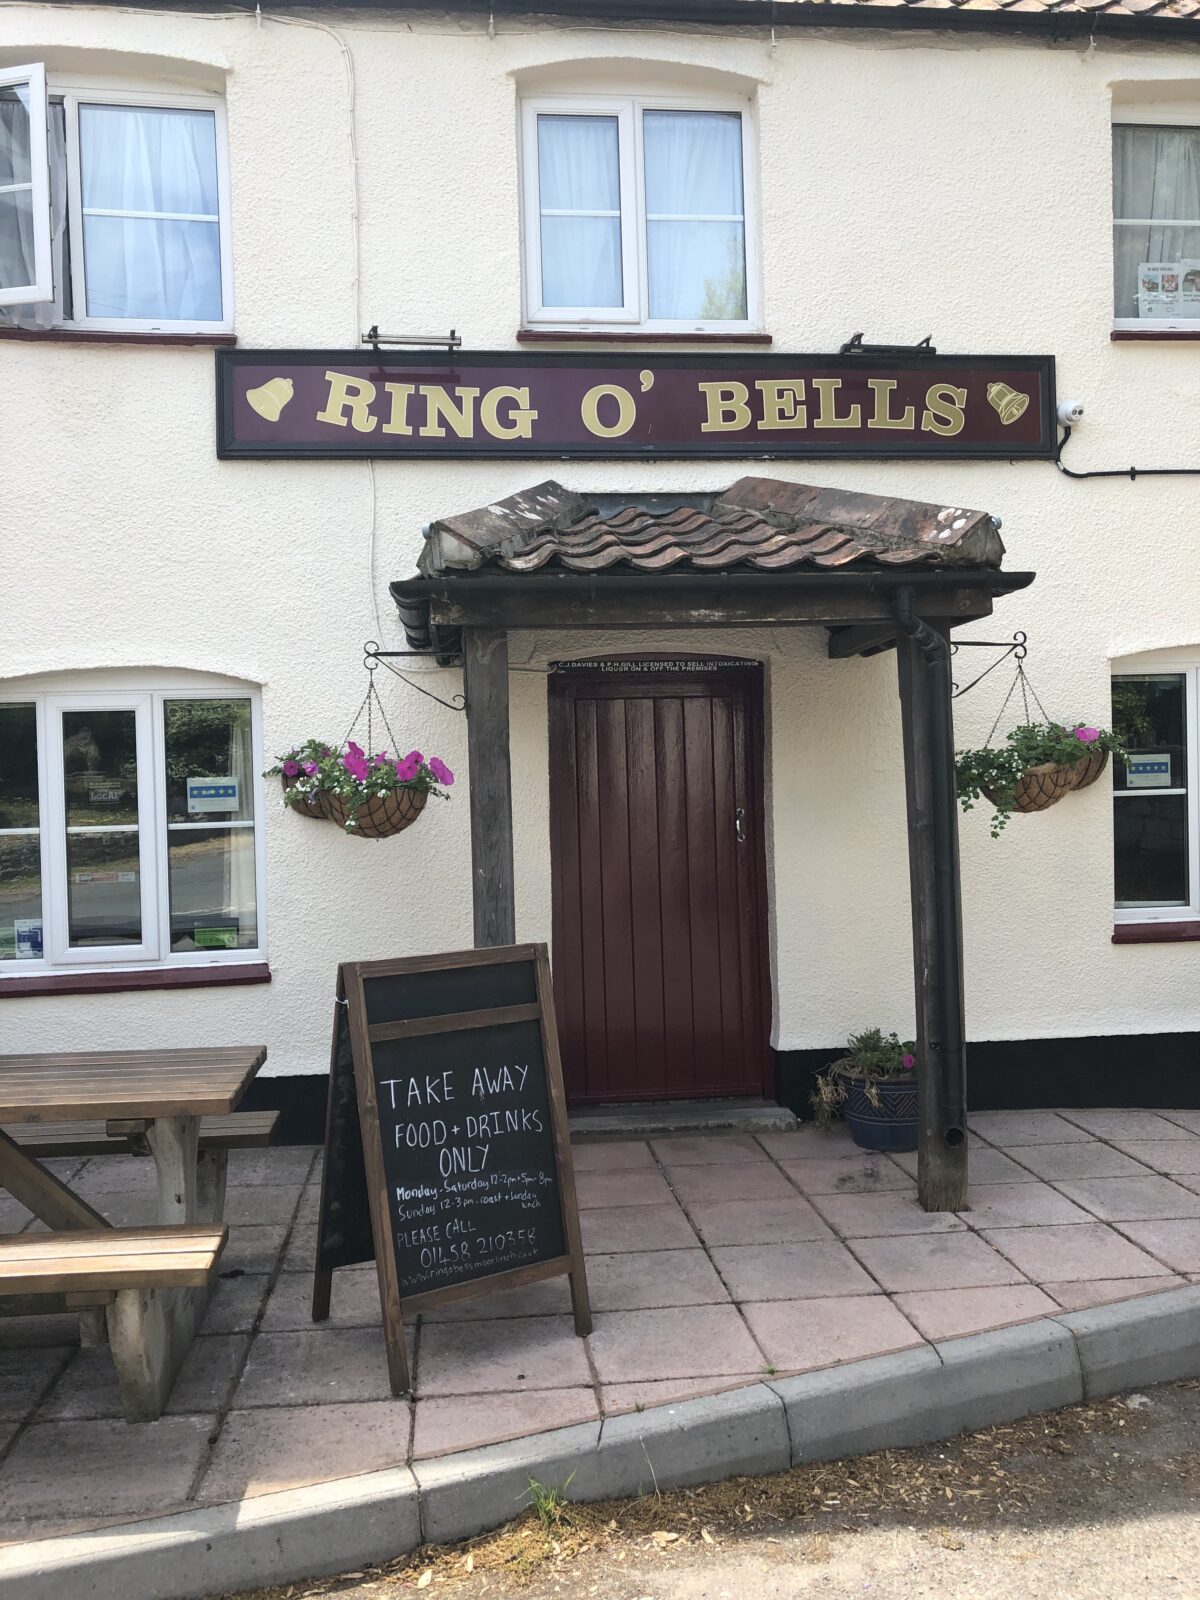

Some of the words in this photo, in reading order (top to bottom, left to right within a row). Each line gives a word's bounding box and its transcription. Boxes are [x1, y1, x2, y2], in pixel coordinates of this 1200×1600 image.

[316, 371, 538, 440] RING
[698, 378, 967, 437] BELLS
[379, 1071, 456, 1109] TAKE
[471, 1064, 529, 1096] AWAY
[395, 1120, 447, 1149] FOOD
[466, 1108, 543, 1139] DRINKS
[439, 1144, 489, 1177] ONLY
[398, 1204, 436, 1221] Sunday
[396, 1225, 441, 1250] PLEASE
[445, 1218, 477, 1239] CALL
[420, 1241, 471, 1268] 01458
[476, 1227, 537, 1254] 210358
